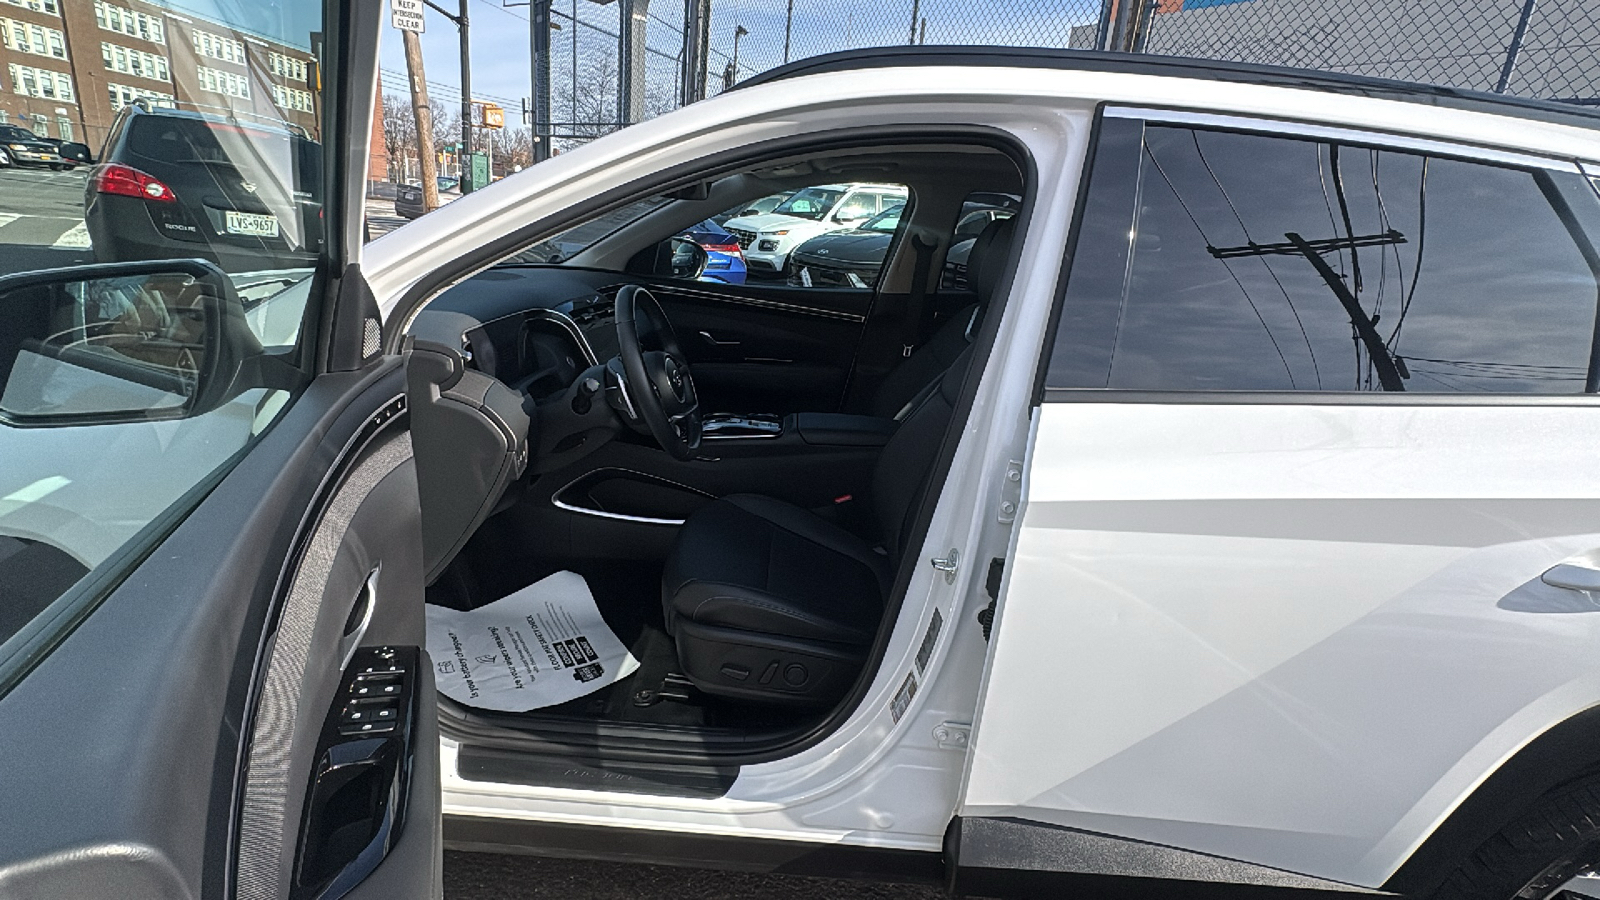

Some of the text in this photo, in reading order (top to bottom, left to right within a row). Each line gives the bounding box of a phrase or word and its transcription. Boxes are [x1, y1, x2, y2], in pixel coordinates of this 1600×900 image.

[398, 0, 416, 10] KEEP
[394, 10, 422, 19] INTERSECTION
[398, 18, 420, 29] CLEAR
[164, 223, 196, 232] ROGUE
[526, 615, 538, 630] CHECK
[533, 630, 547, 647] SAFETY
[542, 644, 552, 654] MAT
[580, 642, 594, 656] COUNT
[501, 650, 513, 666] wipers
[548, 654, 562, 670] FLOOR
[458, 658, 471, 678] battery
[508, 666, 522, 680] your
[466, 680, 479, 692] your
[515, 680, 524, 689] Are
